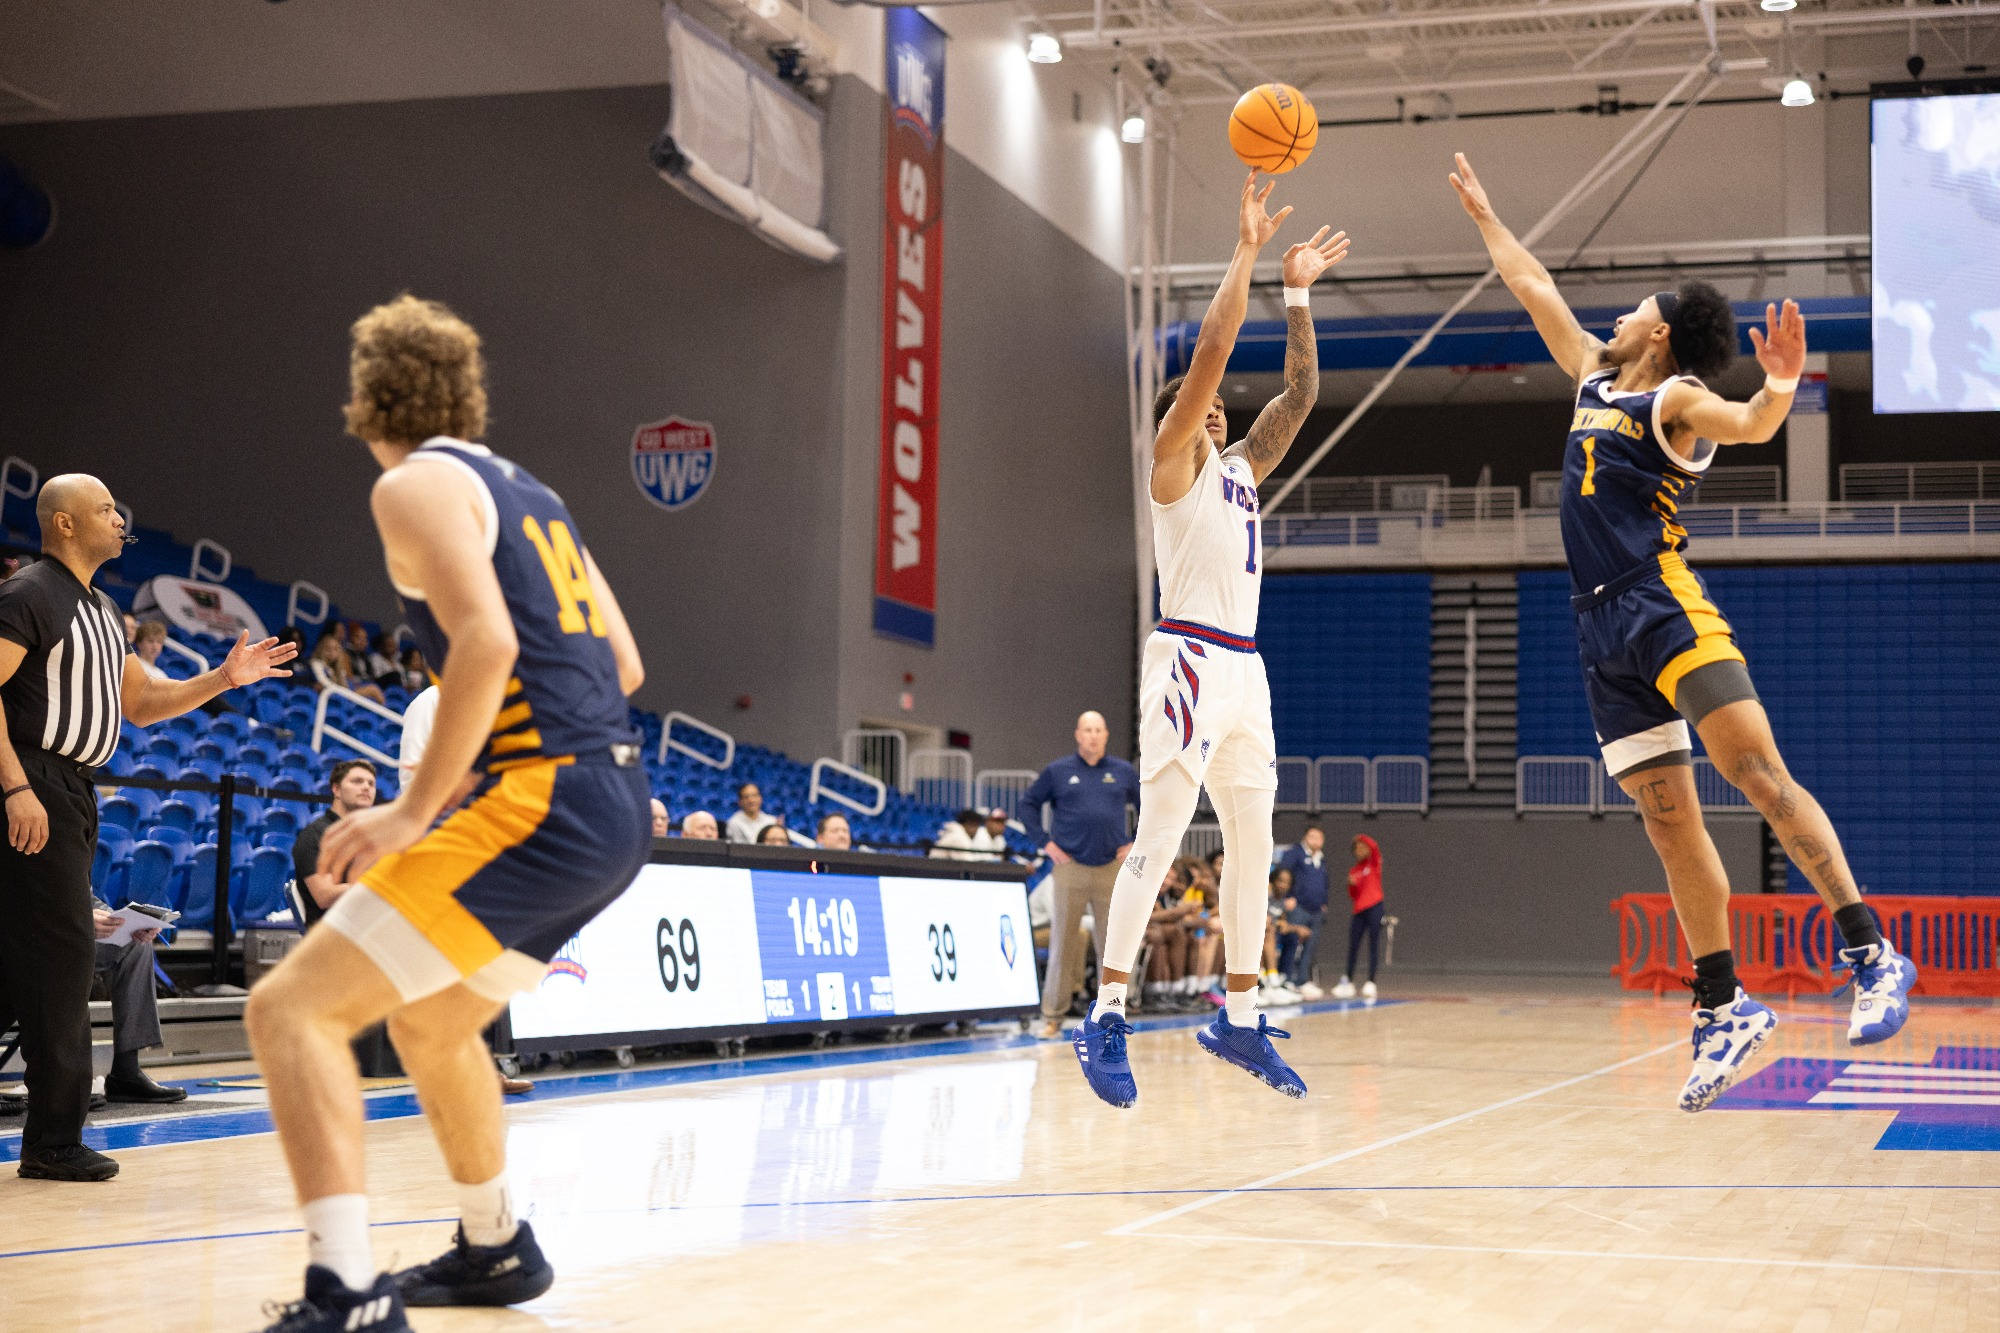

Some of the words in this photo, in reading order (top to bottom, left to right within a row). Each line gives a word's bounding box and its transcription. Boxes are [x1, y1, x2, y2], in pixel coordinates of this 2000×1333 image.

[892, 158, 928, 571] WOLVES
[639, 453, 708, 501] UWG
[1580, 436, 1596, 496] 1
[1245, 519, 1257, 575] 1
[522, 515, 607, 638] 14
[656, 917, 700, 993] 69
[787, 897, 859, 957] 14:19
[928, 923, 957, 982] 39
[765, 998, 795, 1017] FOULS
[801, 979, 811, 1012] 1
[828, 984, 838, 1011] 2
[852, 981, 862, 1012] 1
